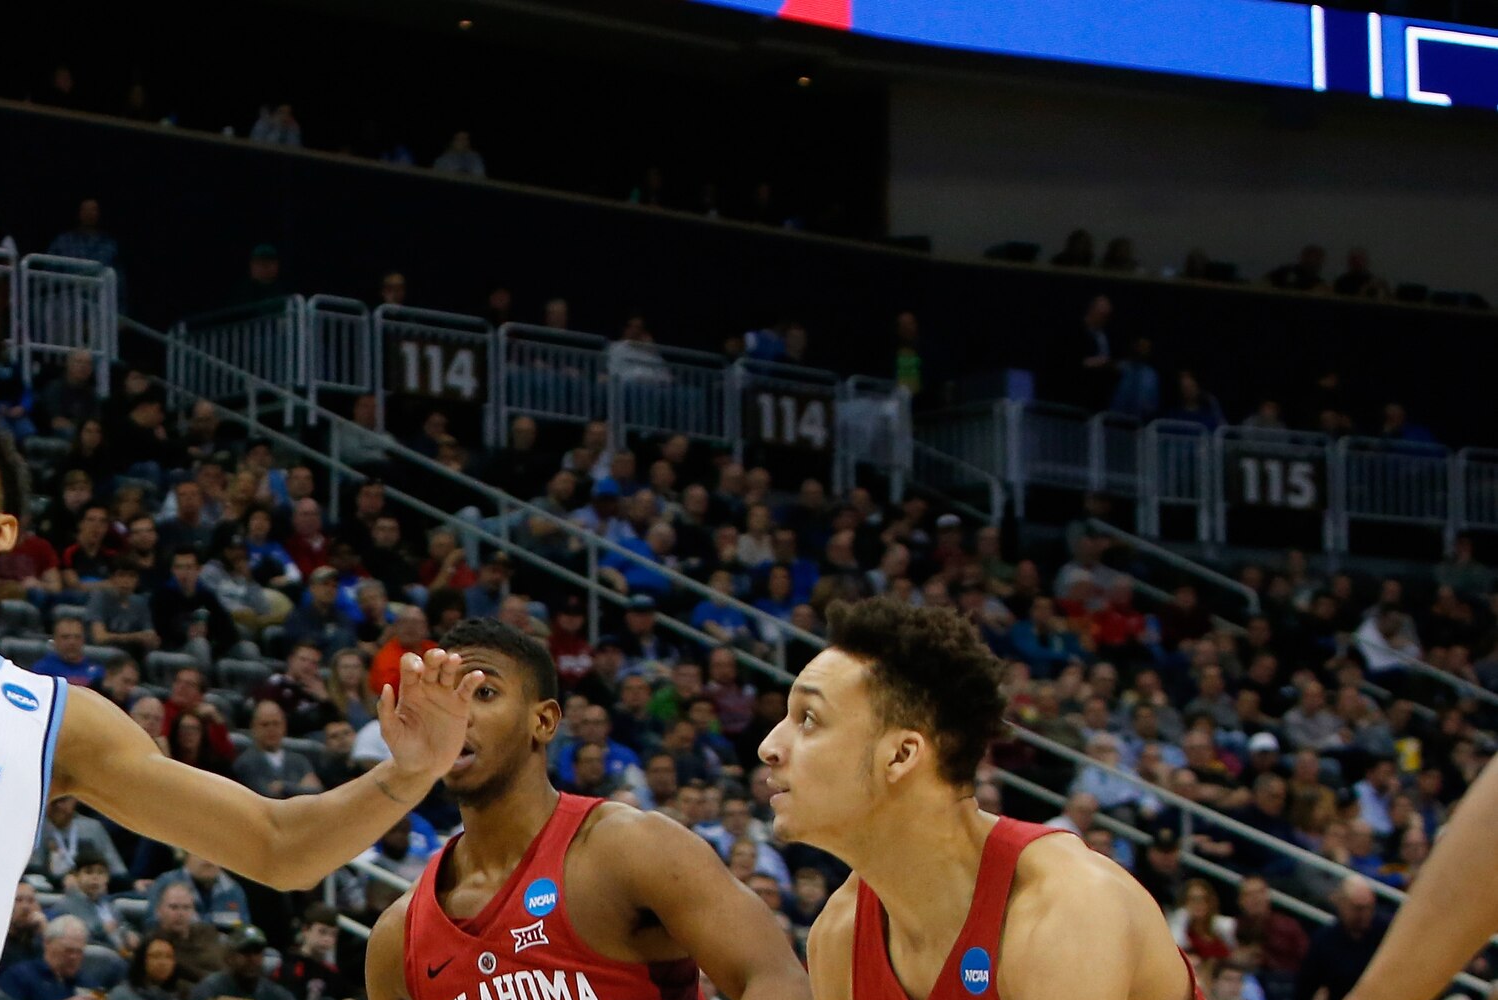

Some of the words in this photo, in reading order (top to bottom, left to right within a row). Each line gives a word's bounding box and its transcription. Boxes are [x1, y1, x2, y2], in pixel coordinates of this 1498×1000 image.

[401, 341, 478, 398] 114
[758, 393, 828, 447] 114
[1240, 458, 1317, 509] 115
[528, 892, 557, 909] NCAA
[964, 969, 989, 983] NCAA
